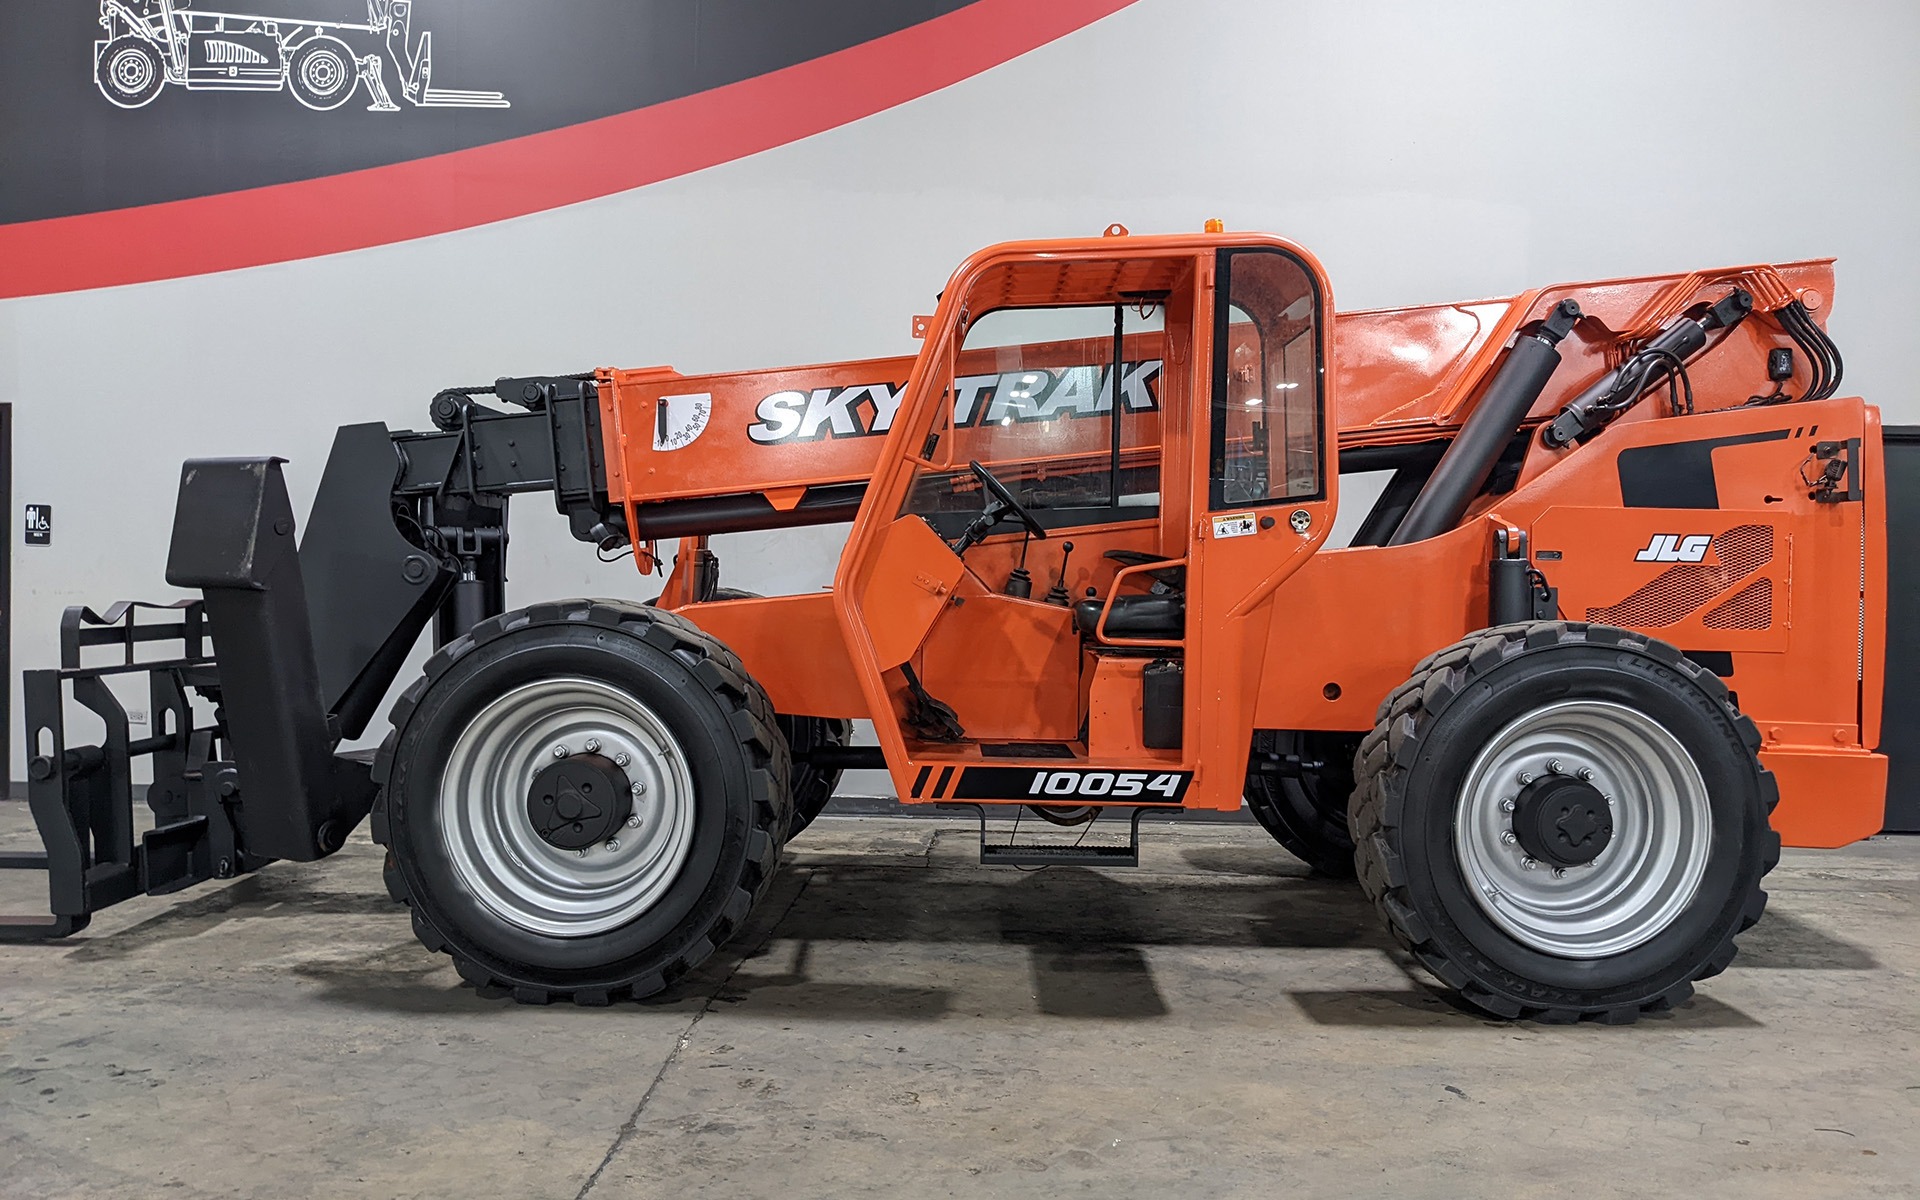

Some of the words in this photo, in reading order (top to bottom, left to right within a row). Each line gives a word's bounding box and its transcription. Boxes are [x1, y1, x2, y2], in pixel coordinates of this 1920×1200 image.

[694, 402, 702, 410] 80
[685, 424, 692, 432] 40
[693, 422, 700, 430] 50
[674, 431, 682, 440] 20
[683, 432, 690, 440] 30
[1635, 534, 1713, 562] JLG
[1628, 657, 1741, 756] LIGHTNING
[1029, 771, 1182, 797] 10054
